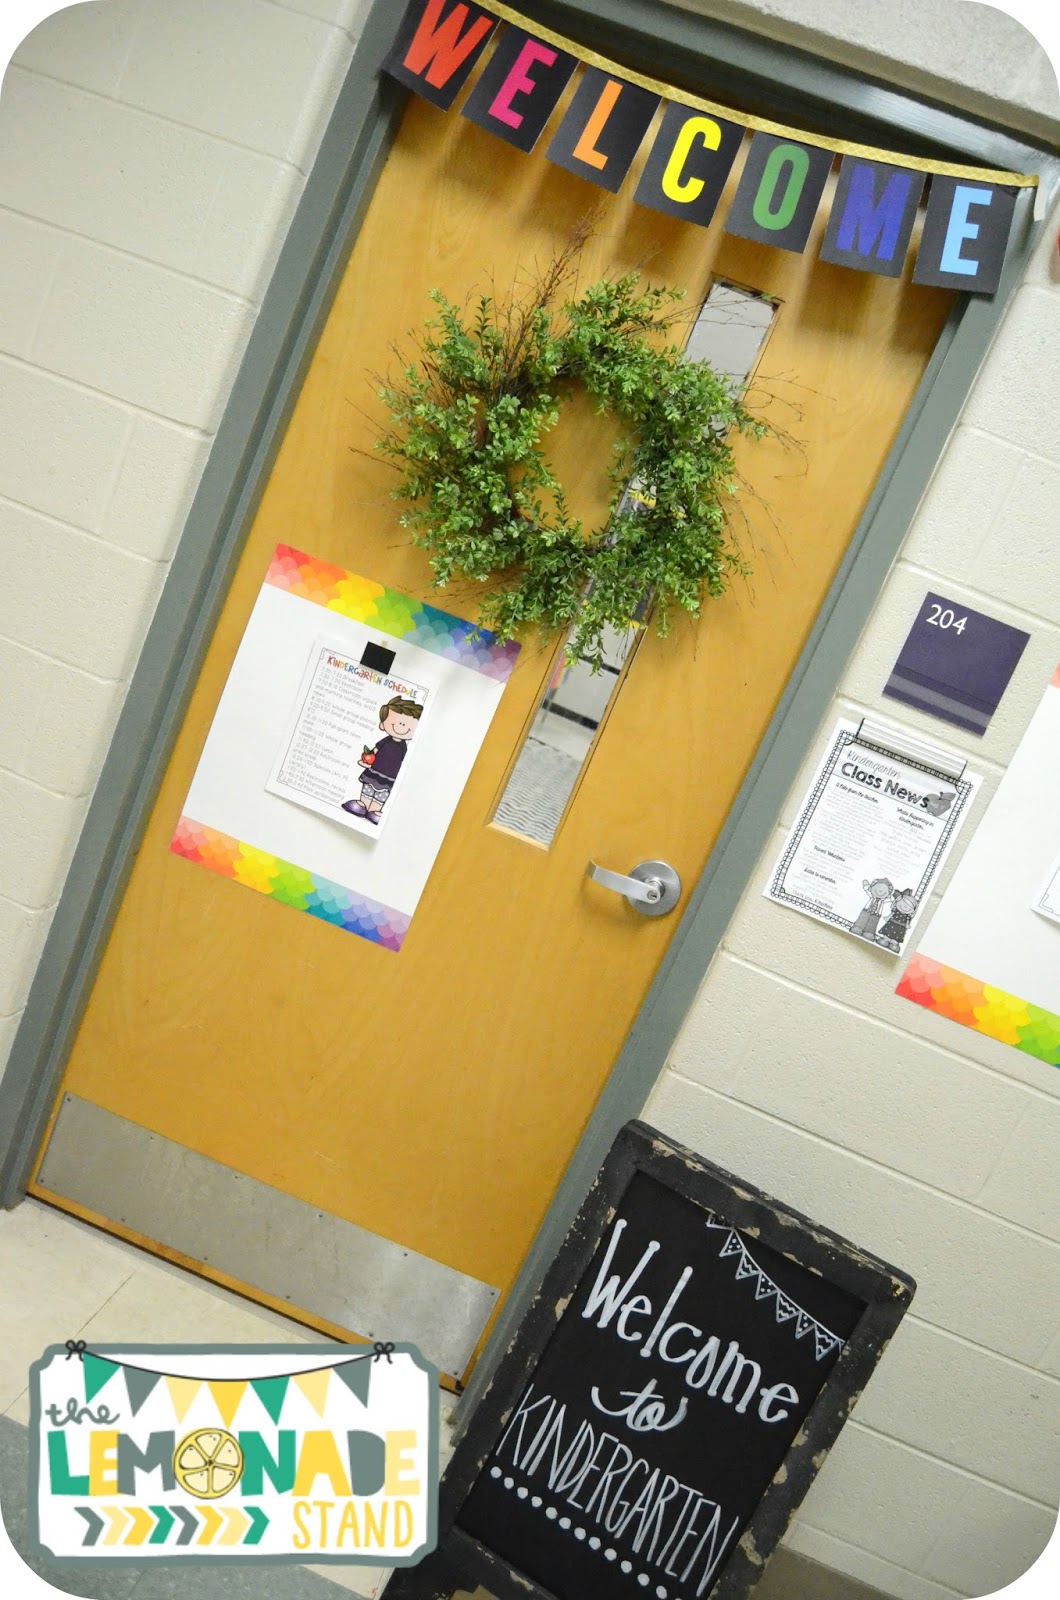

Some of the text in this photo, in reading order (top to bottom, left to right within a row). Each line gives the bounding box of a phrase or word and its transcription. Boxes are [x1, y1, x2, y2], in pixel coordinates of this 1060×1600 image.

[402, 1, 993, 275] WELCOME
[926, 604, 968, 636] 204
[327, 655, 418, 699] KINDERGARTEN SCHEDULE
[841, 762, 930, 809] Class News
[846, 750, 900, 780] Kindergarten
[582, 1219, 799, 1422] Welcome
[591, 1380, 688, 1432] to
[495, 1383, 739, 1598] KINDERGARTEN
